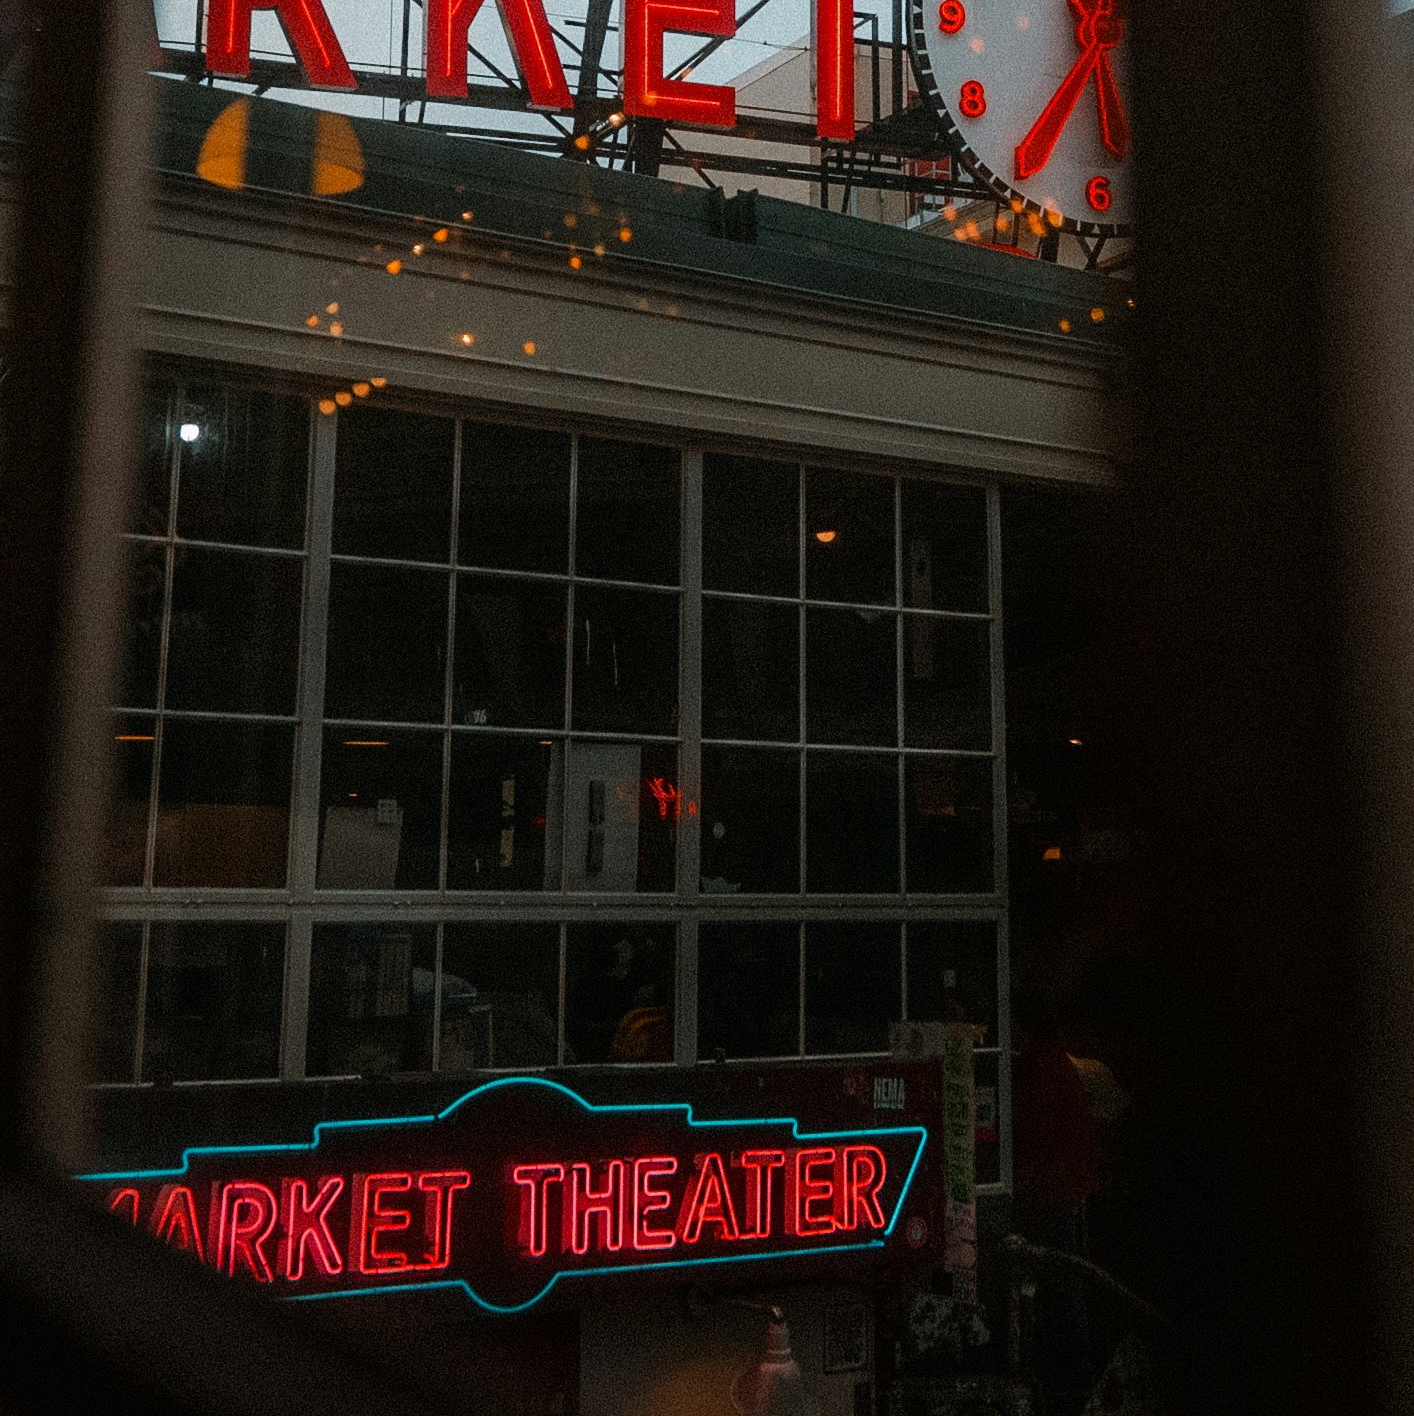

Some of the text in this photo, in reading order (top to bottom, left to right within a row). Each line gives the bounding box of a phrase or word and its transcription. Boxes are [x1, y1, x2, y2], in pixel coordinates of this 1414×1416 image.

[958, 80, 987, 118] 8
[1085, 175, 1112, 212] 6
[510, 1145, 886, 1259] THEATER
